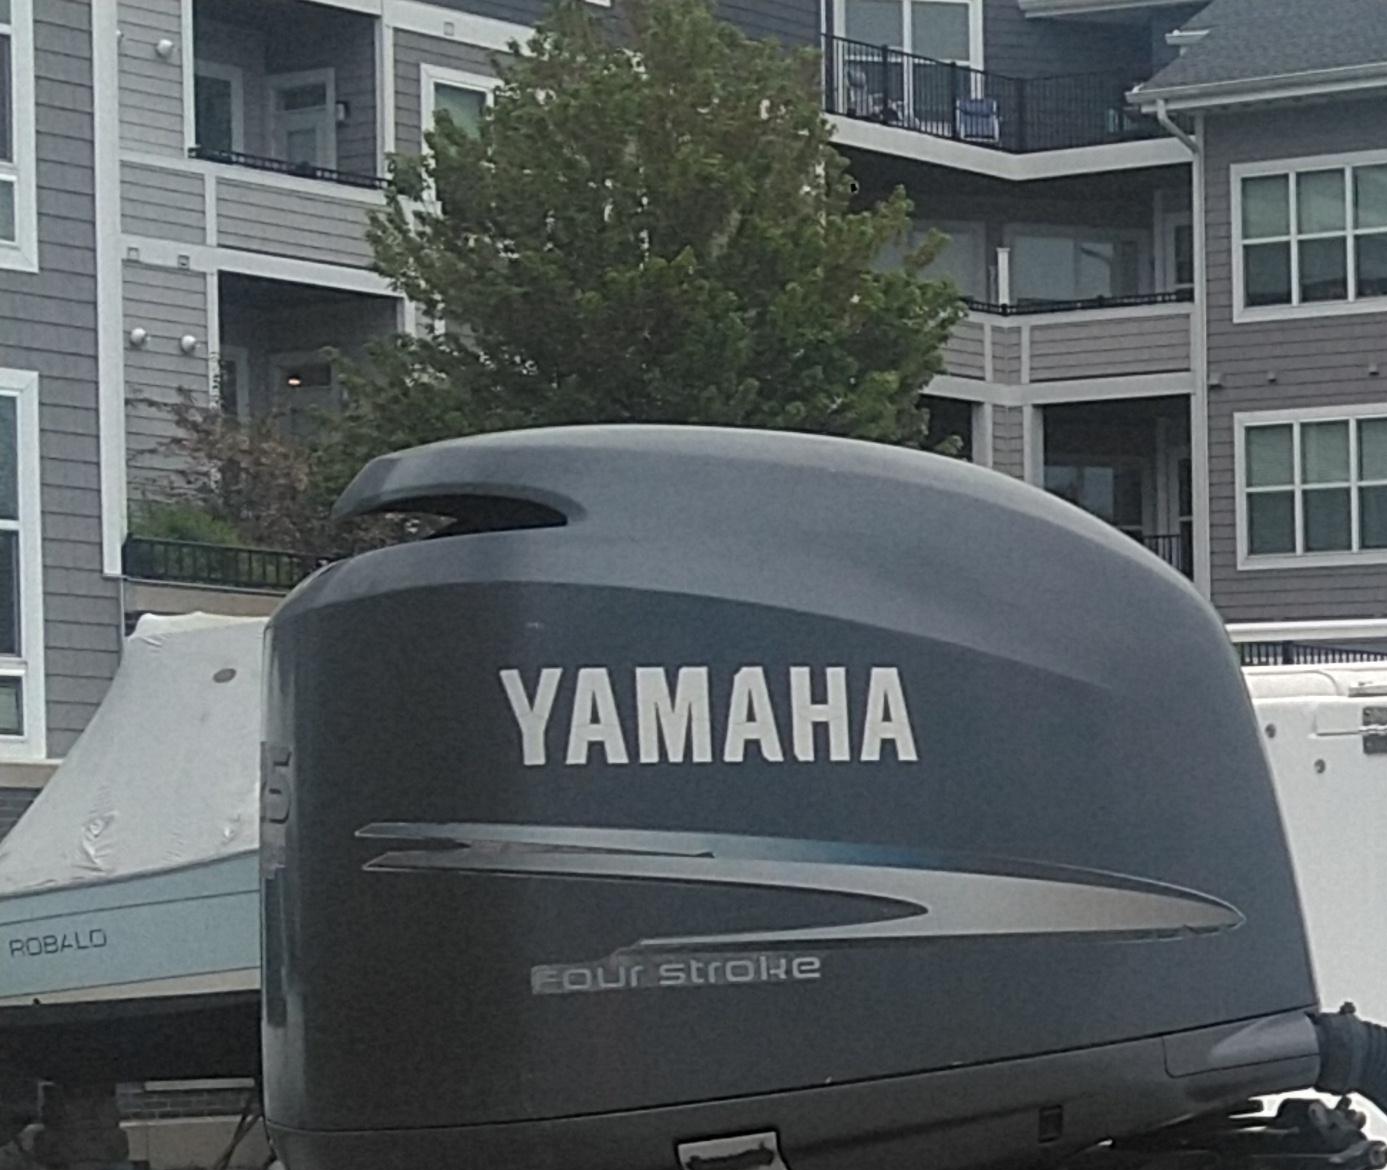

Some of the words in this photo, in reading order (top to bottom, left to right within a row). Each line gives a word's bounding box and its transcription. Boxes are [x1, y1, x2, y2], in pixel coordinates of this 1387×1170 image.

[500, 666, 918, 766] YAMAHA
[8, 928, 108, 957] ROBALO
[659, 956, 821, 986] stroke
